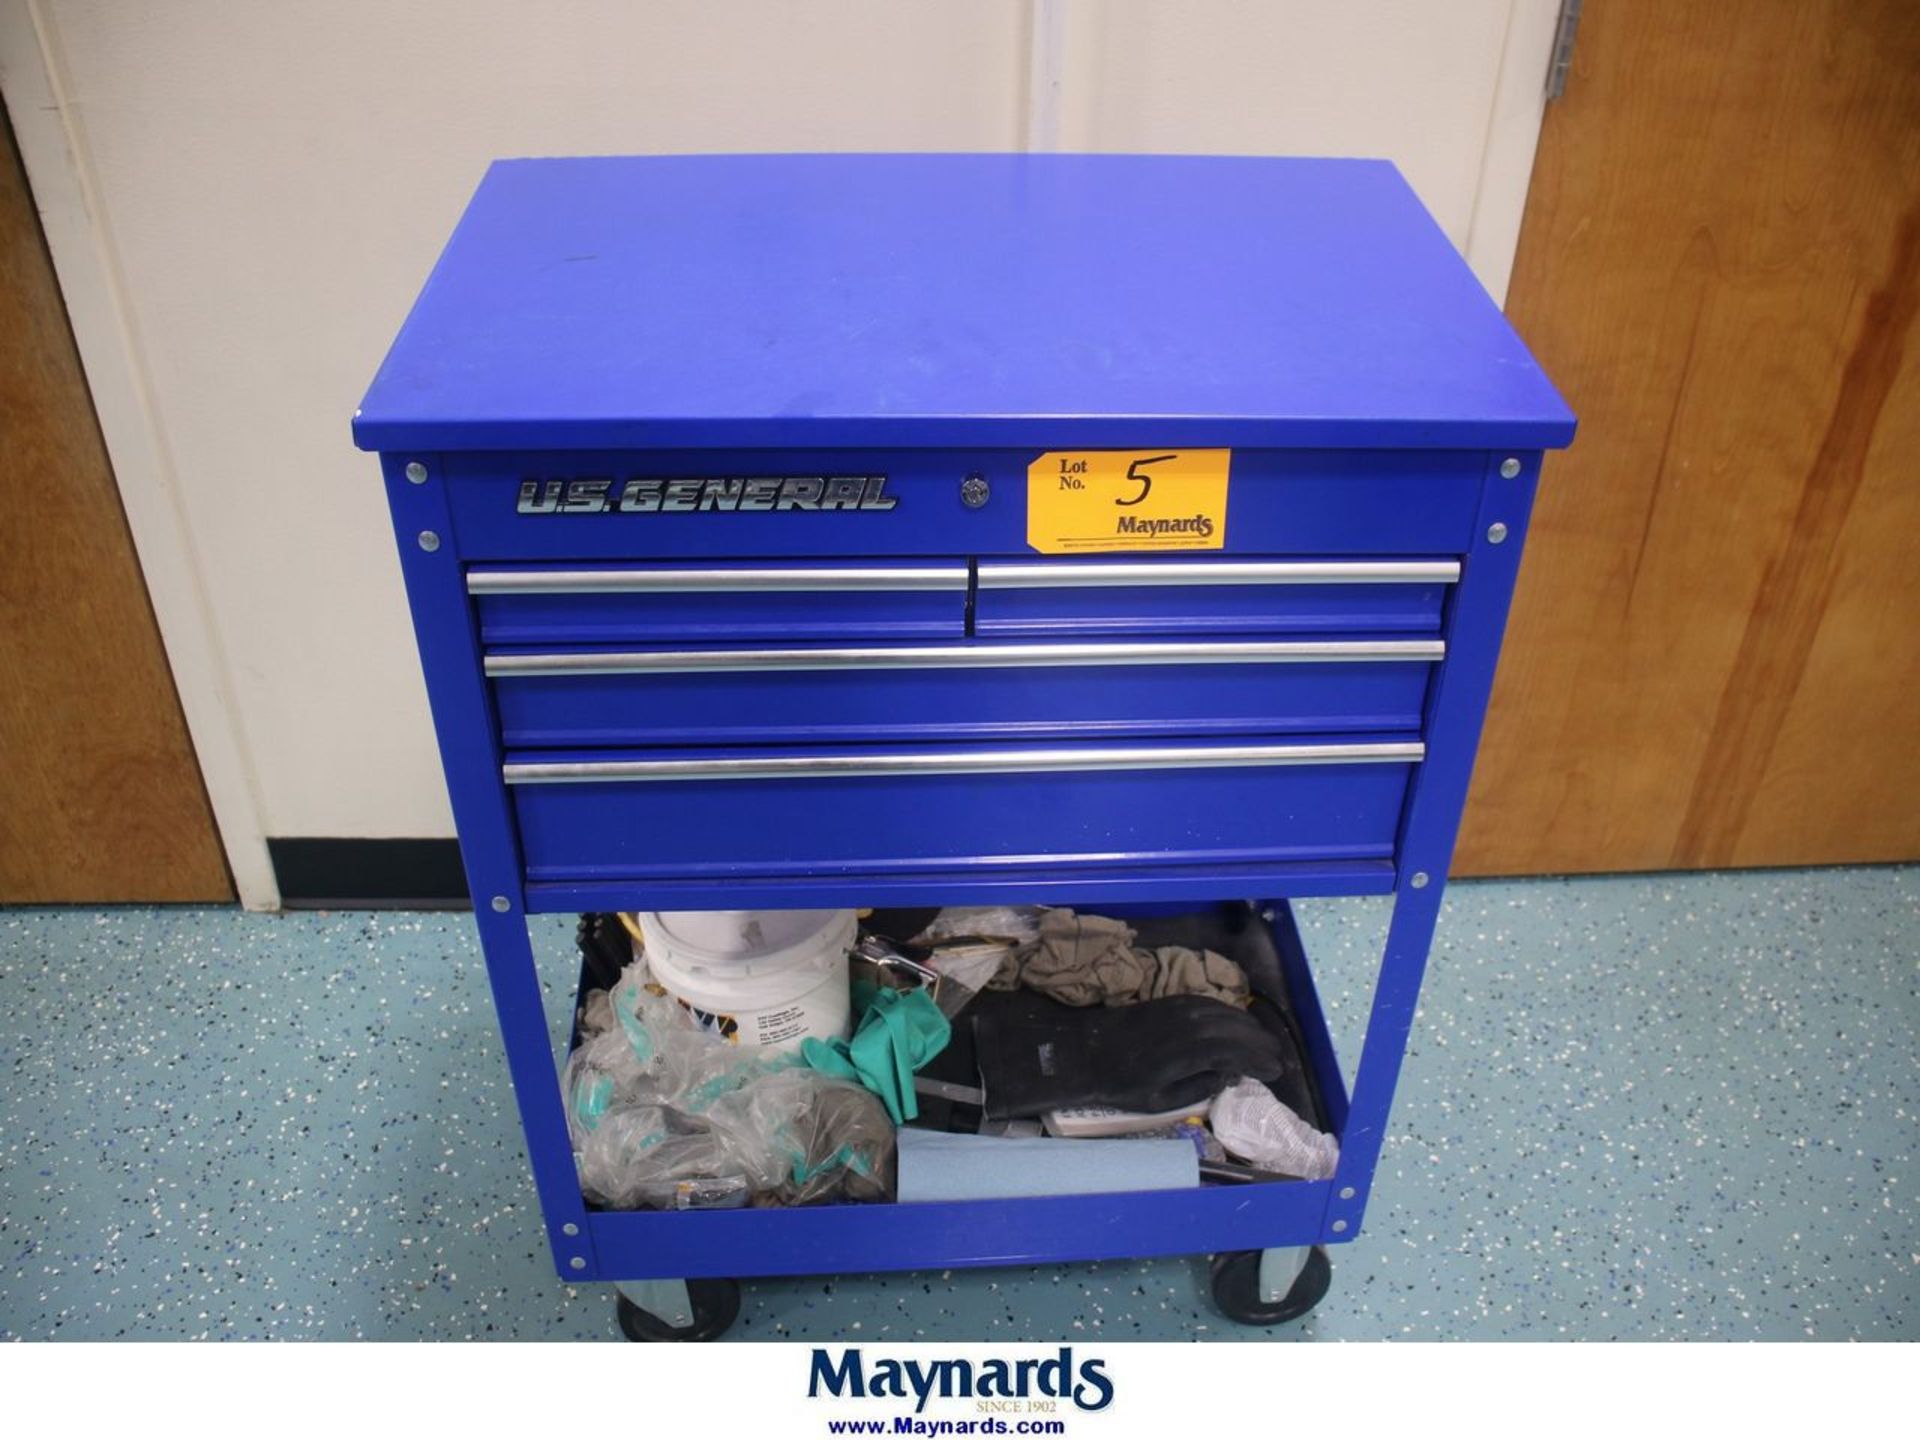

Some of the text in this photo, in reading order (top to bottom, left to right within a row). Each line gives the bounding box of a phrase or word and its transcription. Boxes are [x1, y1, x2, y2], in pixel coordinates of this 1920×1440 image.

[1059, 459, 1087, 474] Lot
[1059, 476, 1086, 490] No.
[1115, 455, 1178, 506] 5
[516, 477, 898, 513] U.S. GENERAL
[1116, 514, 1214, 538] Maynards
